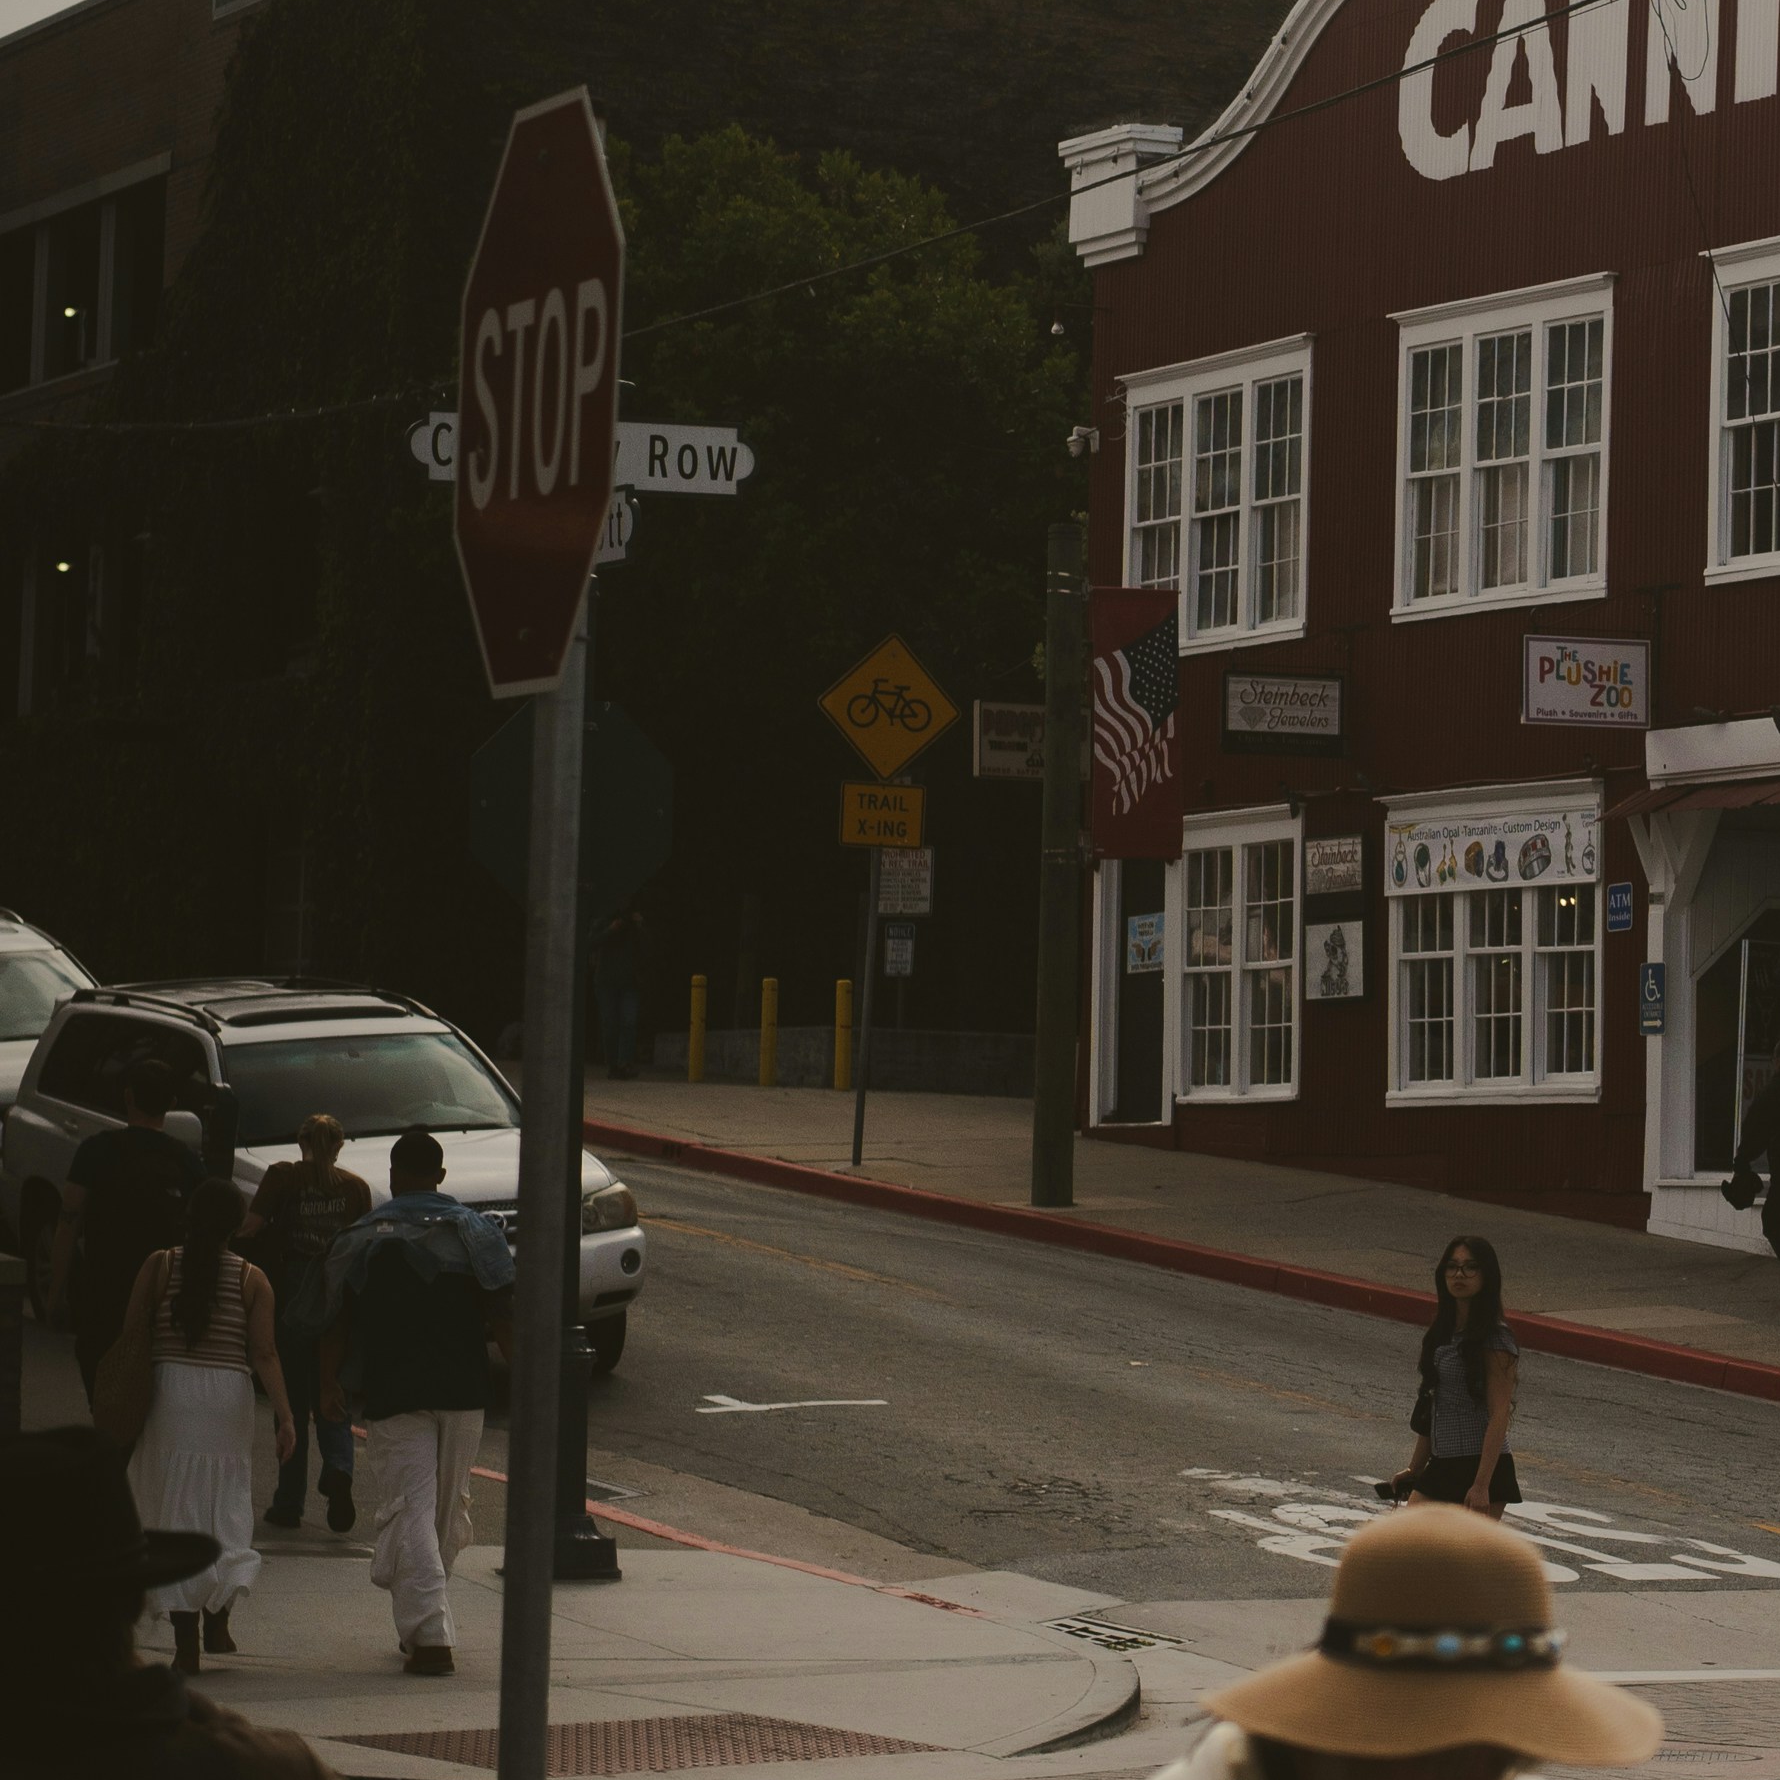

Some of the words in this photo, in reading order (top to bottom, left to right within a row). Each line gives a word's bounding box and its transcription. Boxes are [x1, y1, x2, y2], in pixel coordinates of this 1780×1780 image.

[468, 278, 608, 510] STOP
[1556, 646, 1579, 662] THE
[1240, 679, 1329, 708] Steinbeck
[1589, 684, 1633, 708] ZOO
[1267, 708, 1329, 729] Jewelers
[1536, 708, 1558, 717] Plush
[1569, 709, 1607, 719] Souvenirs
[1617, 711, 1638, 720] Gifts
[857, 792, 909, 814] TRAIL
[856, 818, 908, 838] X-ING
[1406, 827, 1441, 841] Australian
[1442, 826, 1460, 839] Opal
[1502, 822, 1532, 834] Custom
[1534, 820, 1561, 834] Design
[1609, 892, 1631, 909] ATM
[1608, 911, 1631, 922] Inside
